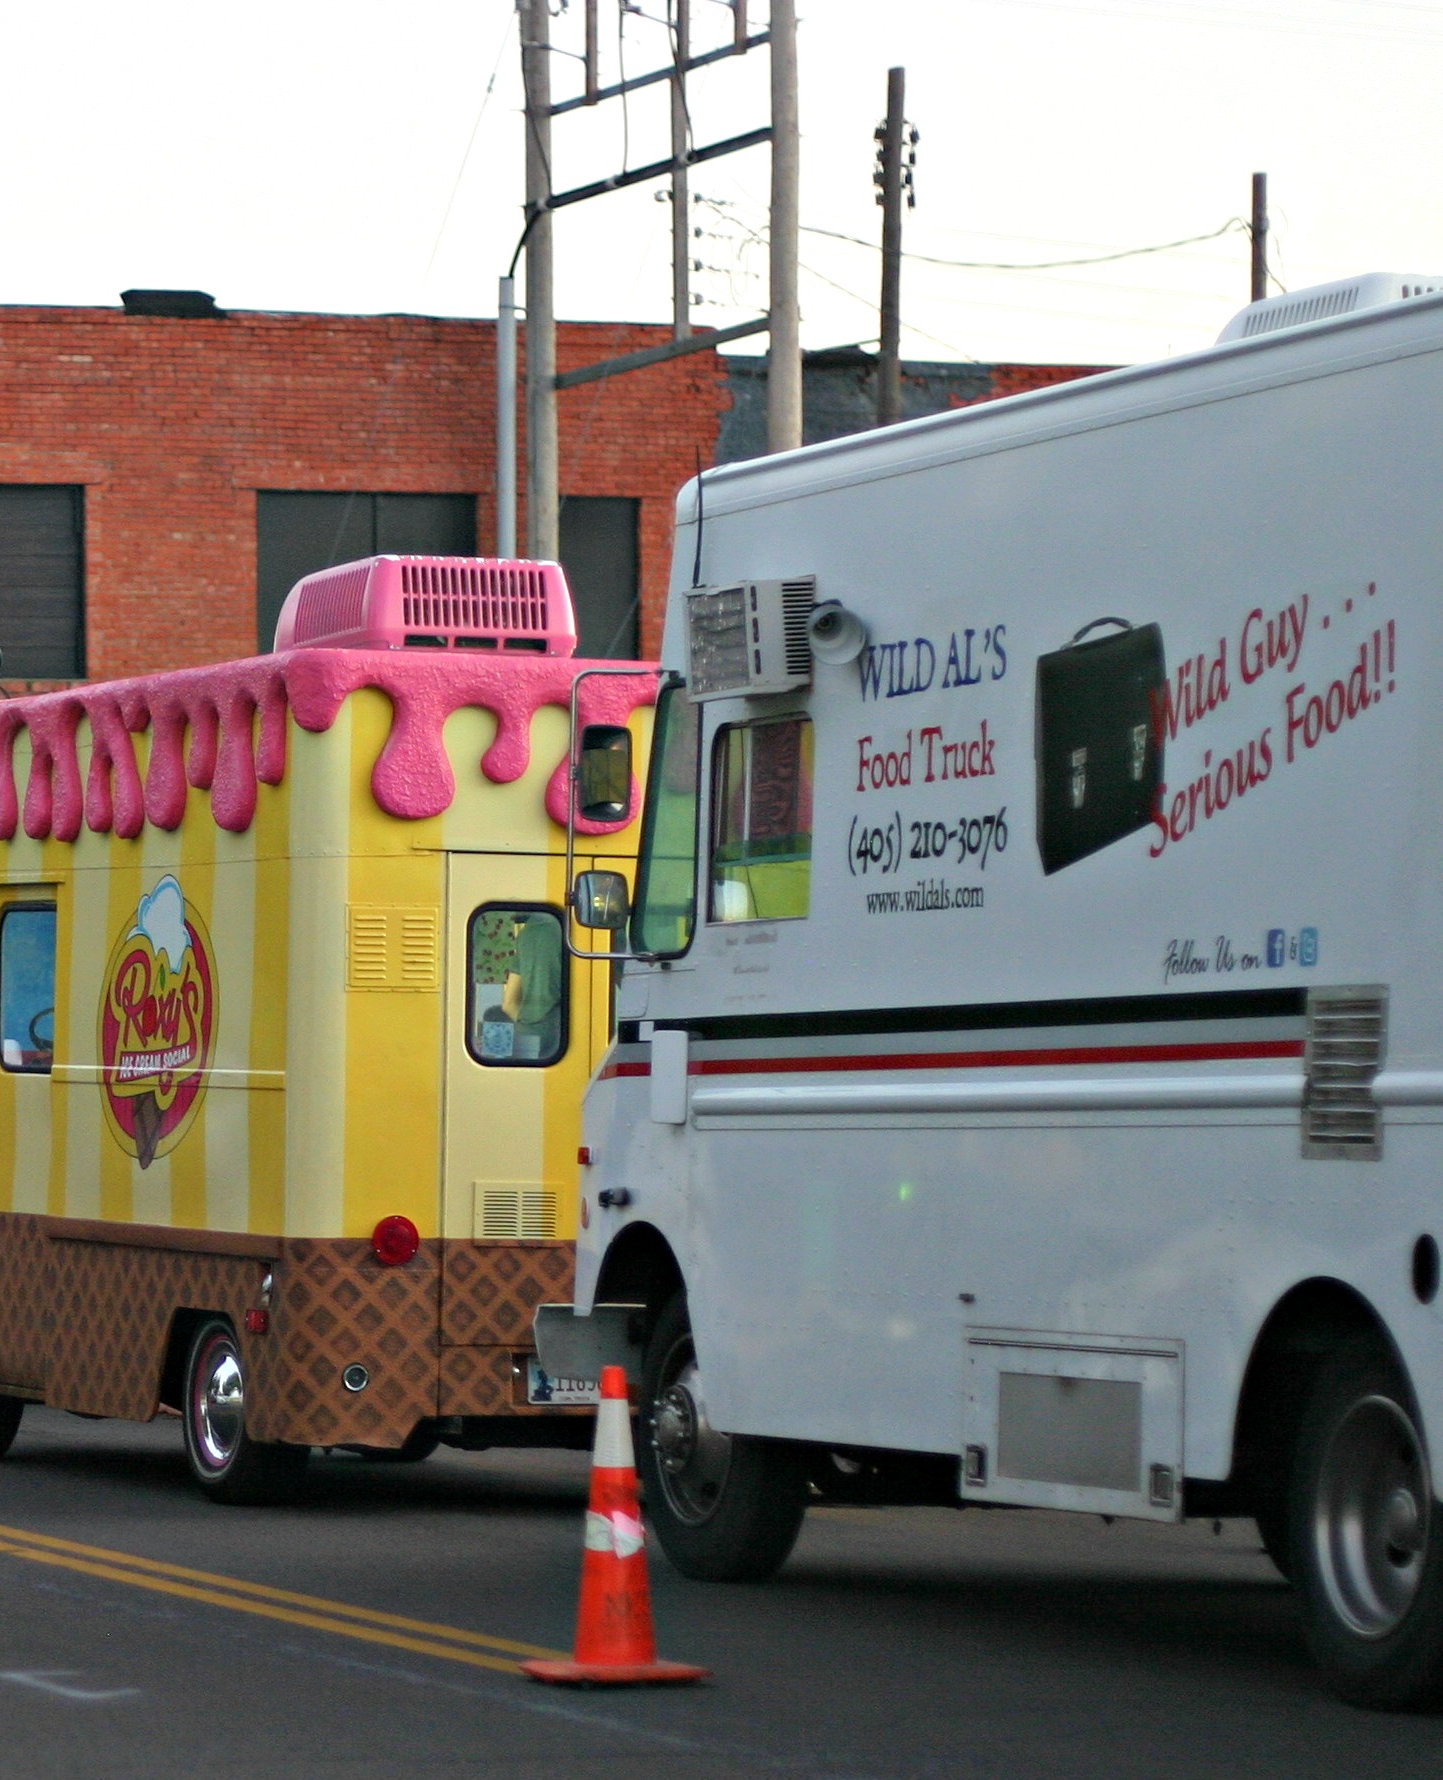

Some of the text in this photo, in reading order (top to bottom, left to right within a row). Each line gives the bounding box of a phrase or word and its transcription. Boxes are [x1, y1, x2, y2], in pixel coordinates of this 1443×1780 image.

[858, 637, 936, 702] WILD
[1149, 636, 1231, 750] Wild
[856, 718, 995, 792] Food Truck
[1149, 726, 1273, 858] Serious
[847, 805, 1008, 877] (405) 210-3076
[866, 878, 985, 914] www.wildals.com
